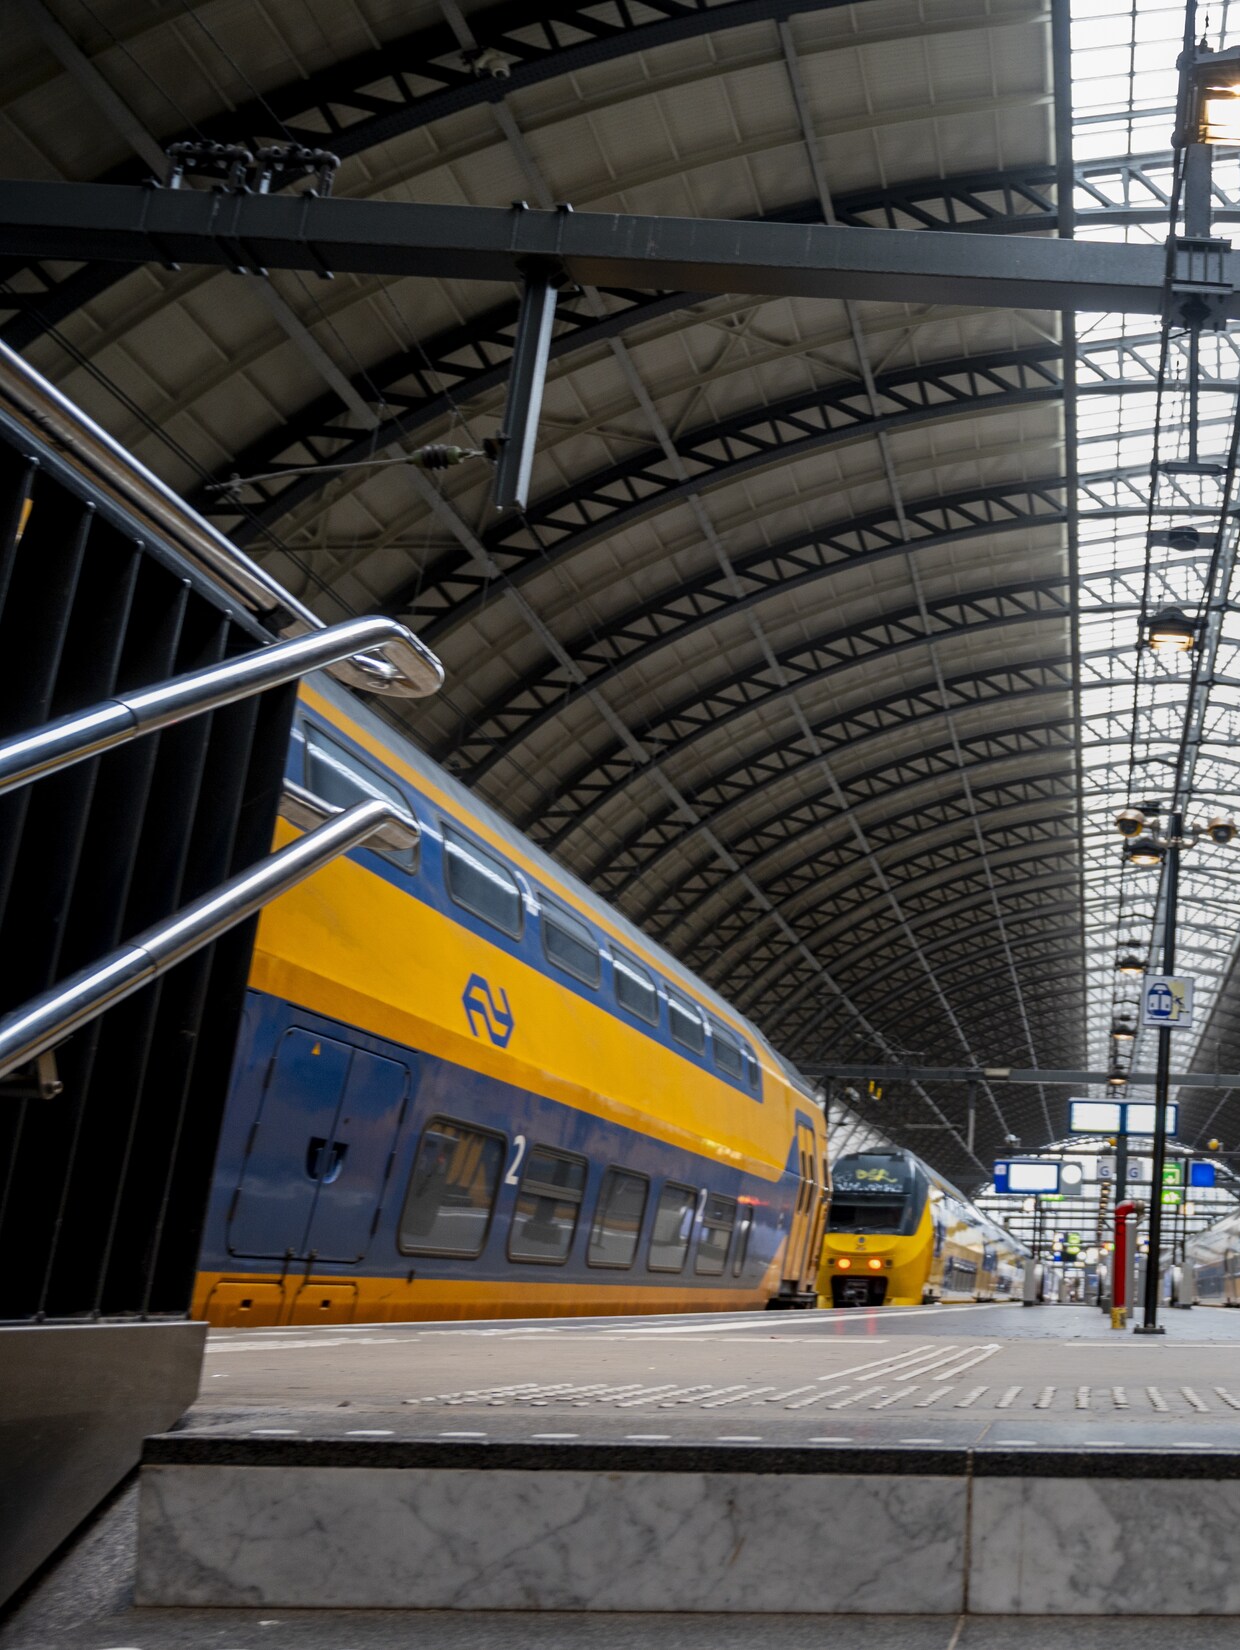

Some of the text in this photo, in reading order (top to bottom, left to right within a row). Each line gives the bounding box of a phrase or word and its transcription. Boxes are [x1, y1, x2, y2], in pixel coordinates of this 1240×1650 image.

[505, 1135, 526, 1185] 2
[1099, 1165, 1110, 1176] G
[1129, 1167, 1139, 1178] G
